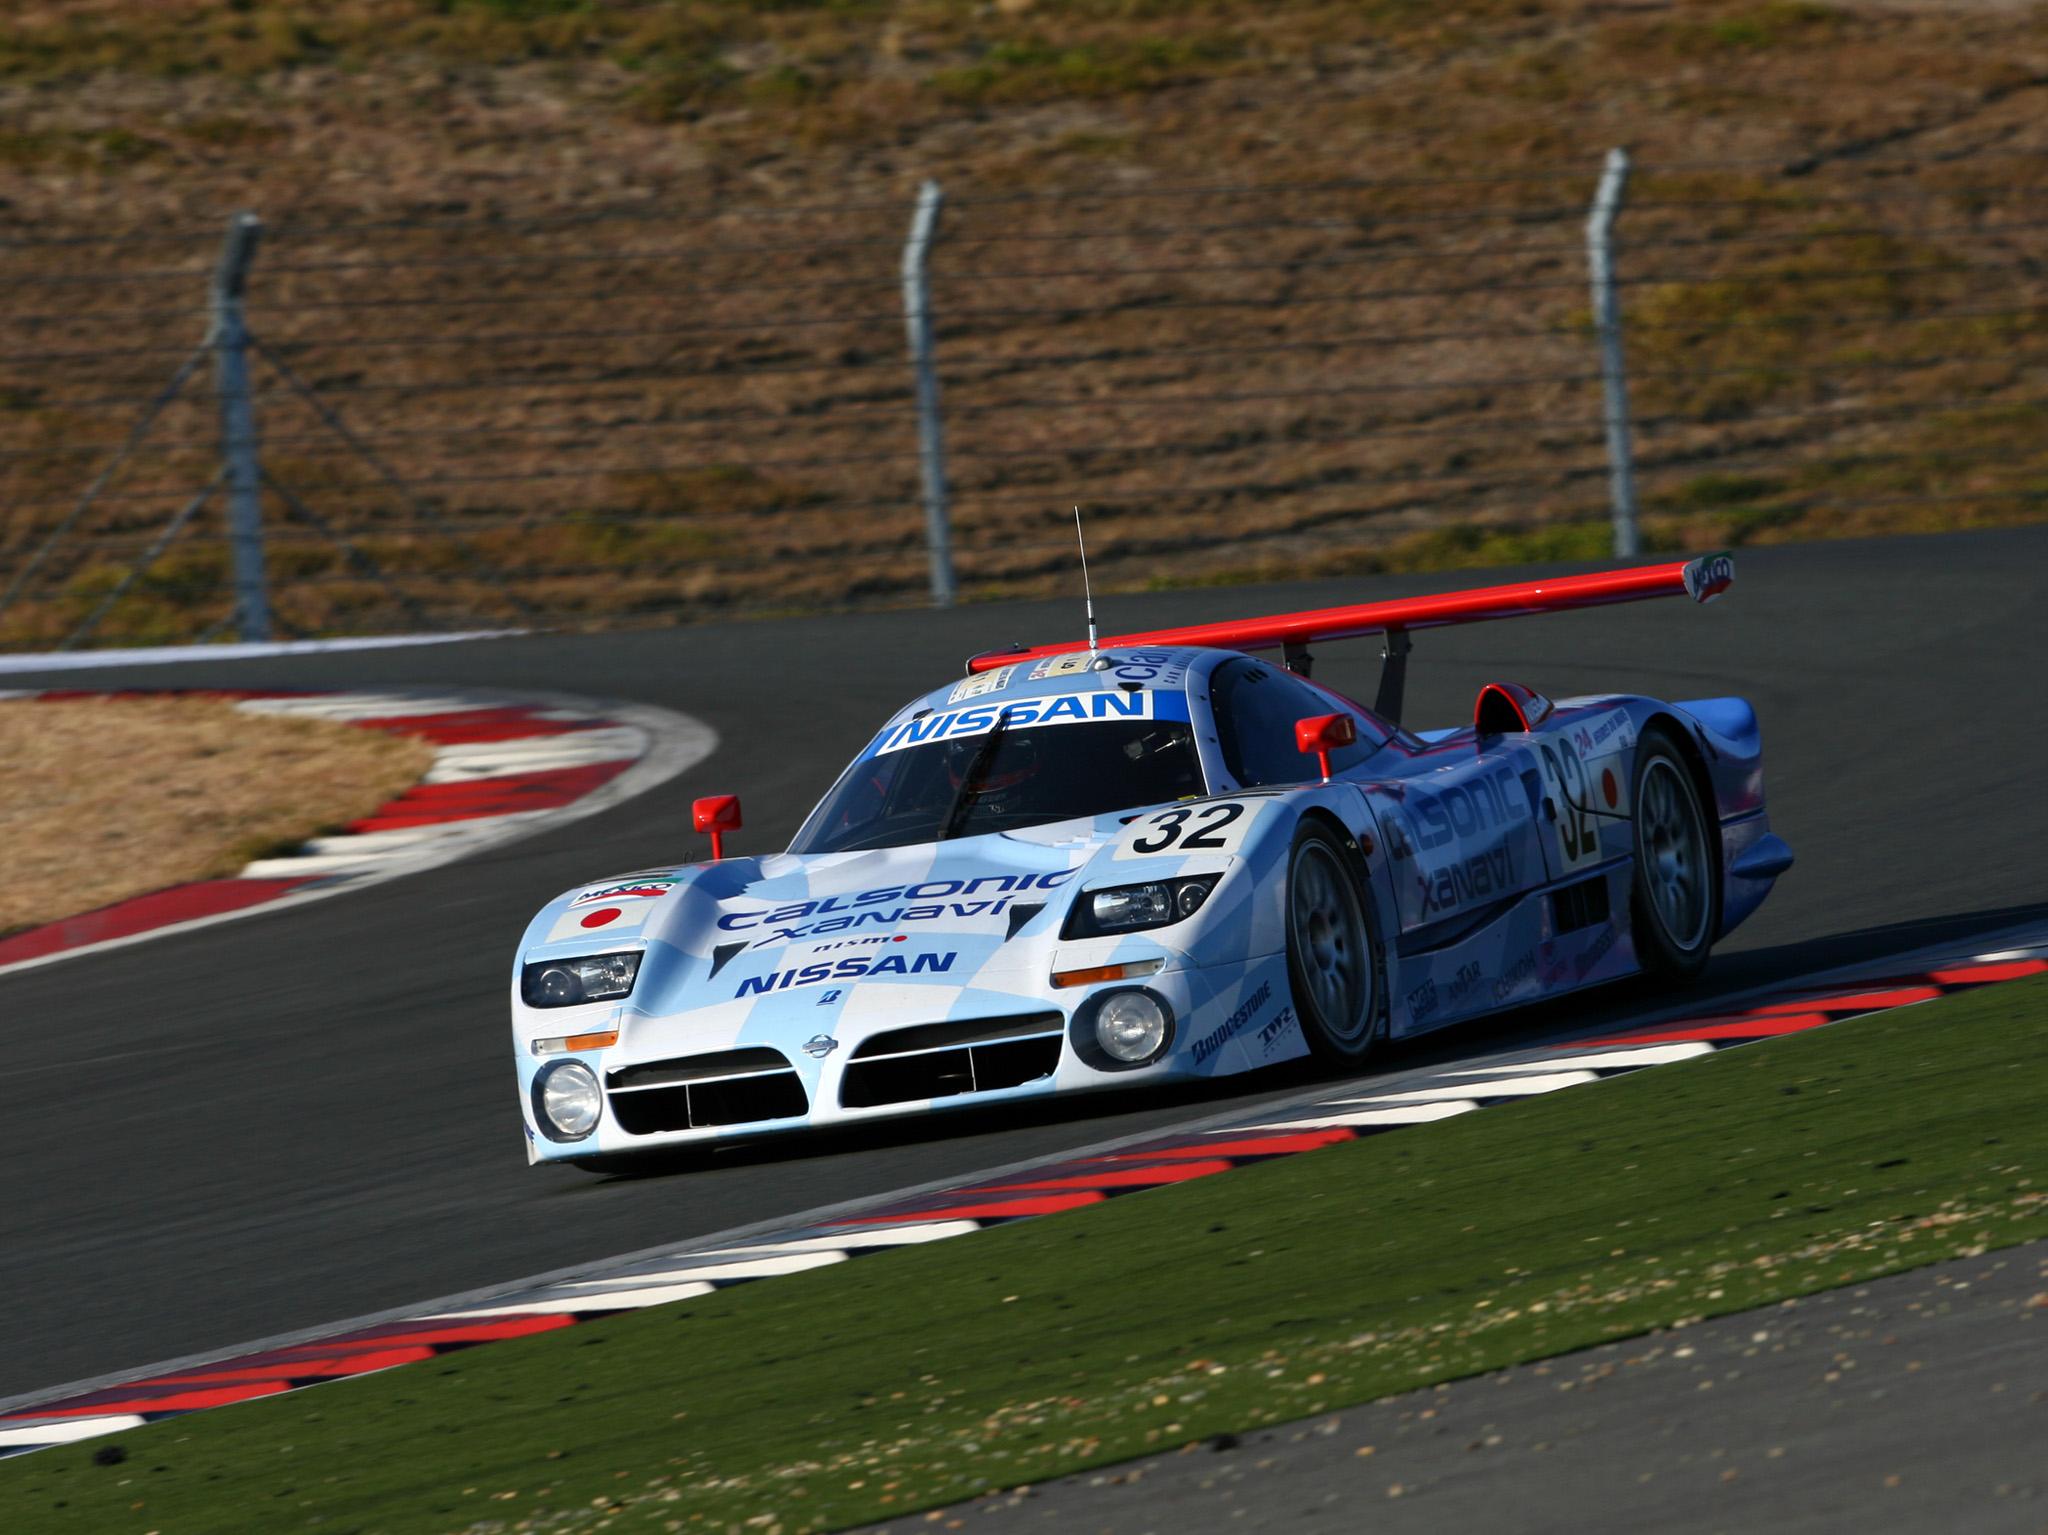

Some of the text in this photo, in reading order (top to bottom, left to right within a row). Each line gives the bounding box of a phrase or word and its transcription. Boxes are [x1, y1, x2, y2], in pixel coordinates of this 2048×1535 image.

[889, 692, 1145, 745] NISSAN
[1541, 738, 1596, 862] 32
[1133, 803, 1244, 853] 32
[734, 952, 957, 999] NISSAN
